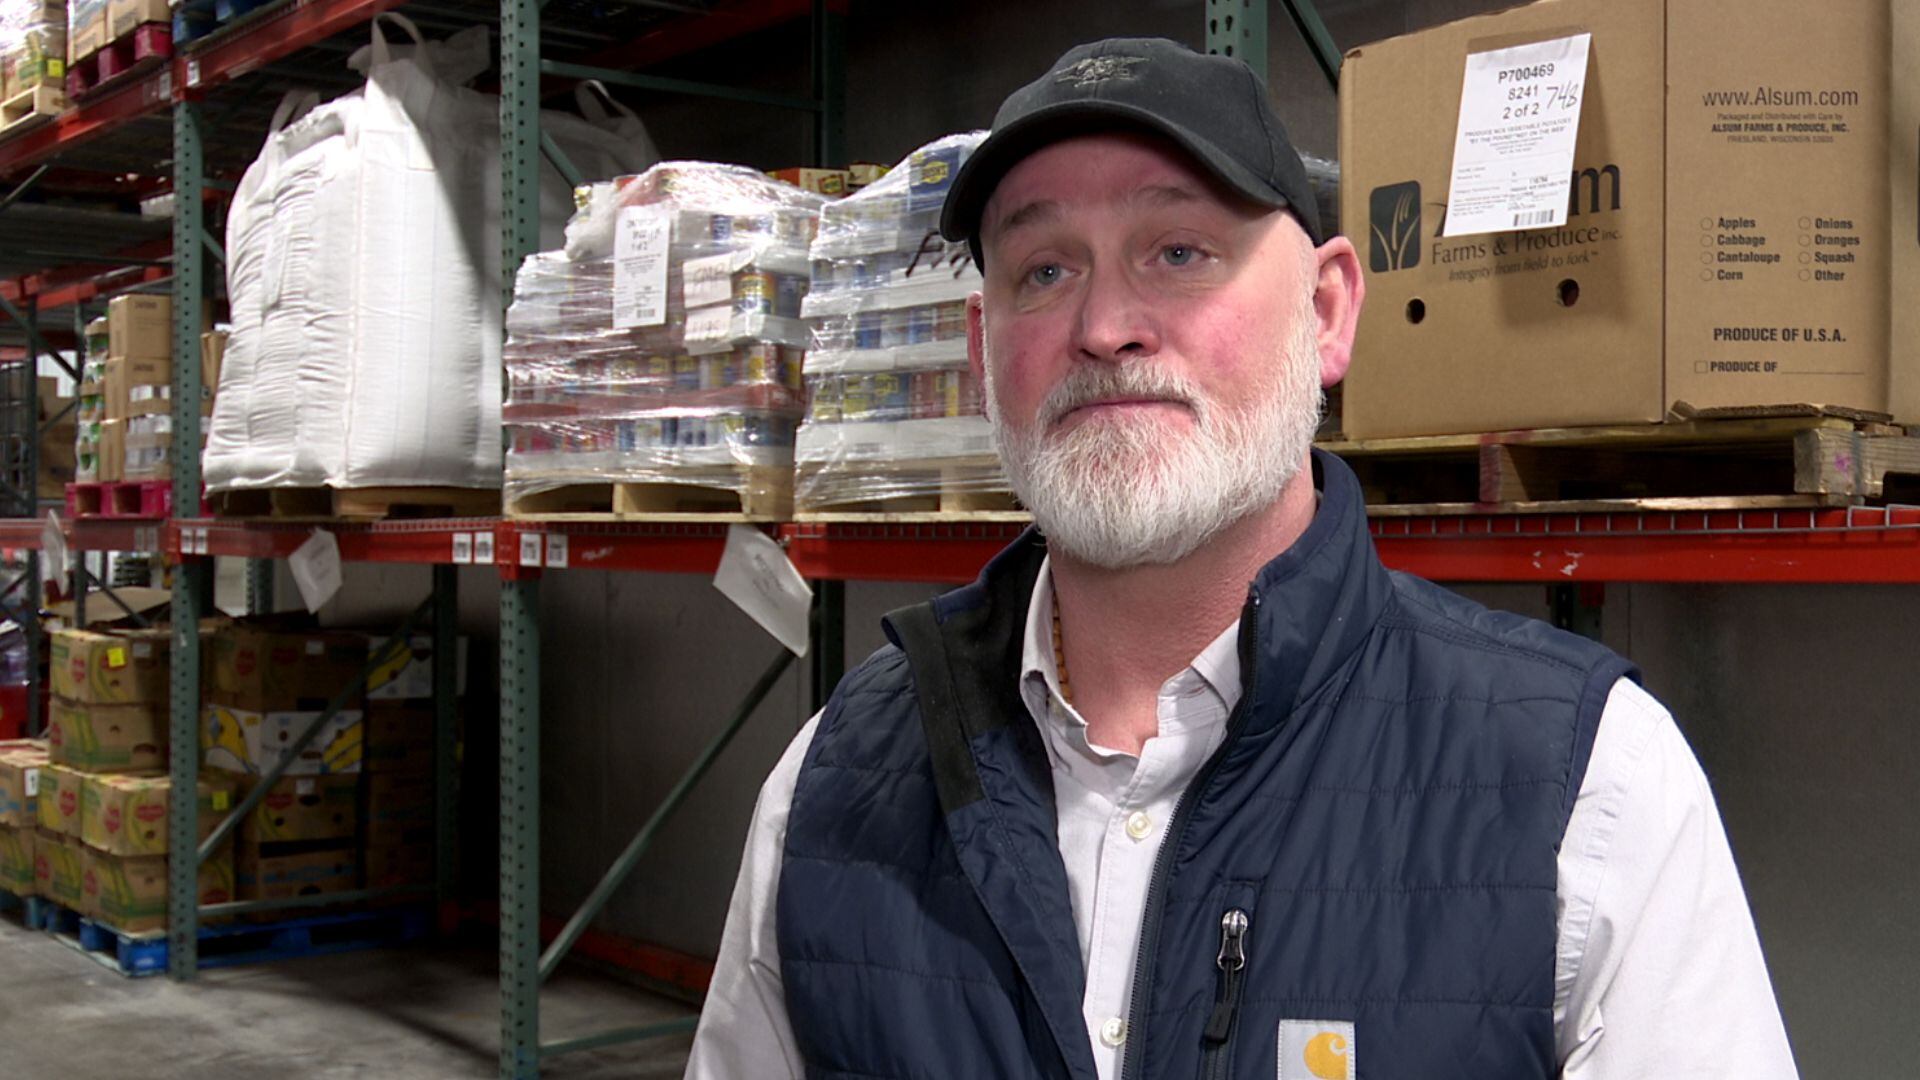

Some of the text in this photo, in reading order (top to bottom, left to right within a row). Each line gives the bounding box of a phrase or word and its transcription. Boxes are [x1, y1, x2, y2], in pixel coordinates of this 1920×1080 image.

[1498, 63, 1555, 84] P700469
[1508, 85, 1538, 101] 8241
[1702, 86, 1859, 107] www.Alsum.com
[1502, 102, 1540, 119] 2 of 2
[1711, 123, 1850, 134] ALSUM FARMS & PRODUCE, INC.
[1718, 217, 1756, 230] Apples
[1815, 217, 1853, 230] Onions
[1431, 242, 1487, 265] Farms
[1493, 237, 1507, 257] &
[1514, 225, 1600, 253] Produce
[1717, 234, 1766, 247] Cabbage
[1814, 234, 1860, 248] Oranges
[1717, 252, 1780, 265] Cantaloupe
[1814, 252, 1855, 265] Squash
[1449, 265, 1491, 283] Integrity
[1495, 261, 1521, 275] from
[1523, 255, 1549, 272] field
[1552, 255, 1563, 267] to
[1717, 269, 1743, 281] Corn
[1814, 269, 1845, 281] Other
[1713, 327, 1847, 342] PRODUCE OF U.S.A.
[1710, 361, 1778, 373] PRODUCE OF
